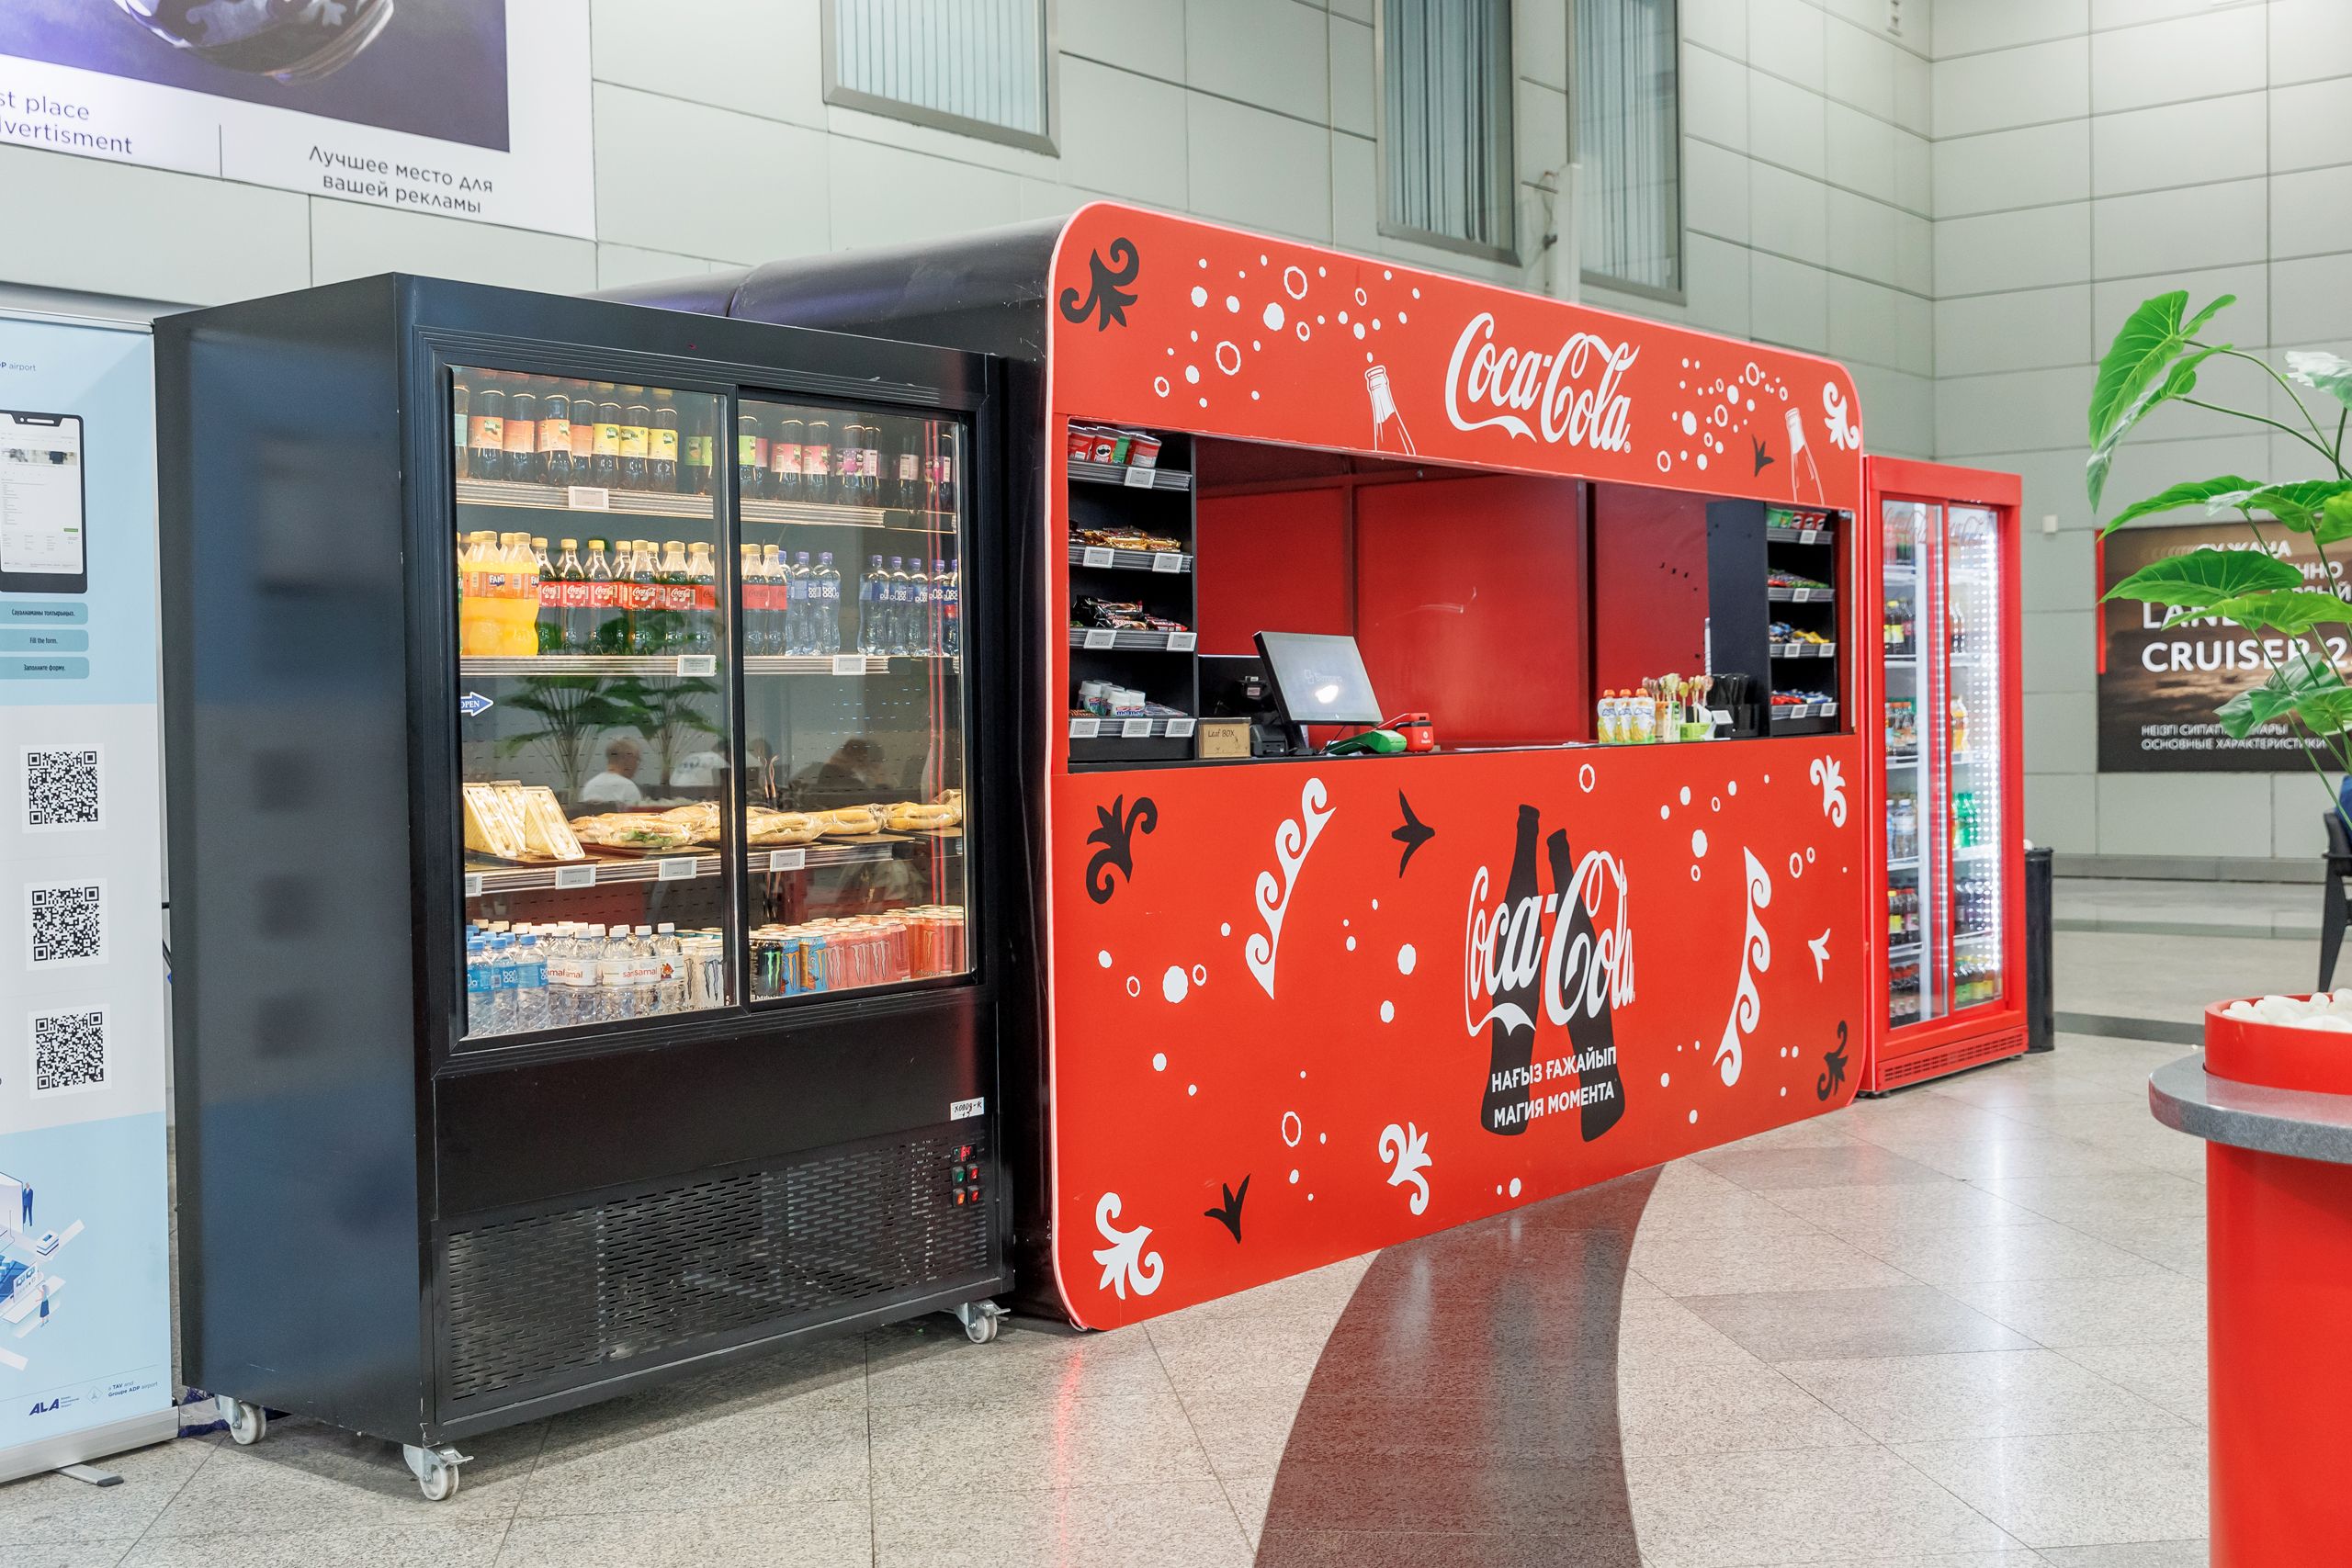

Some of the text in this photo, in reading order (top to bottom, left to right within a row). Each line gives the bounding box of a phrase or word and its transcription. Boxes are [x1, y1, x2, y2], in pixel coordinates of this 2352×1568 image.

[26, 96, 89, 120] place
[309, 145, 492, 193] Лучшее место для
[323, 175, 481, 213] вашей рекламы
[9, 362, 36, 371] airport
[1445, 312, 1640, 452] Coca-Cola
[1464, 851, 1634, 1036] Coca-Cola
[1491, 1046, 1617, 1093] НАҒЫЗ ҒАЖАЙЫП
[1494, 1080, 1615, 1129] МАГИЯ МОМЕНТА
[28, 1397, 60, 1416] ALA
[107, 1389, 128, 1397] Groupe
